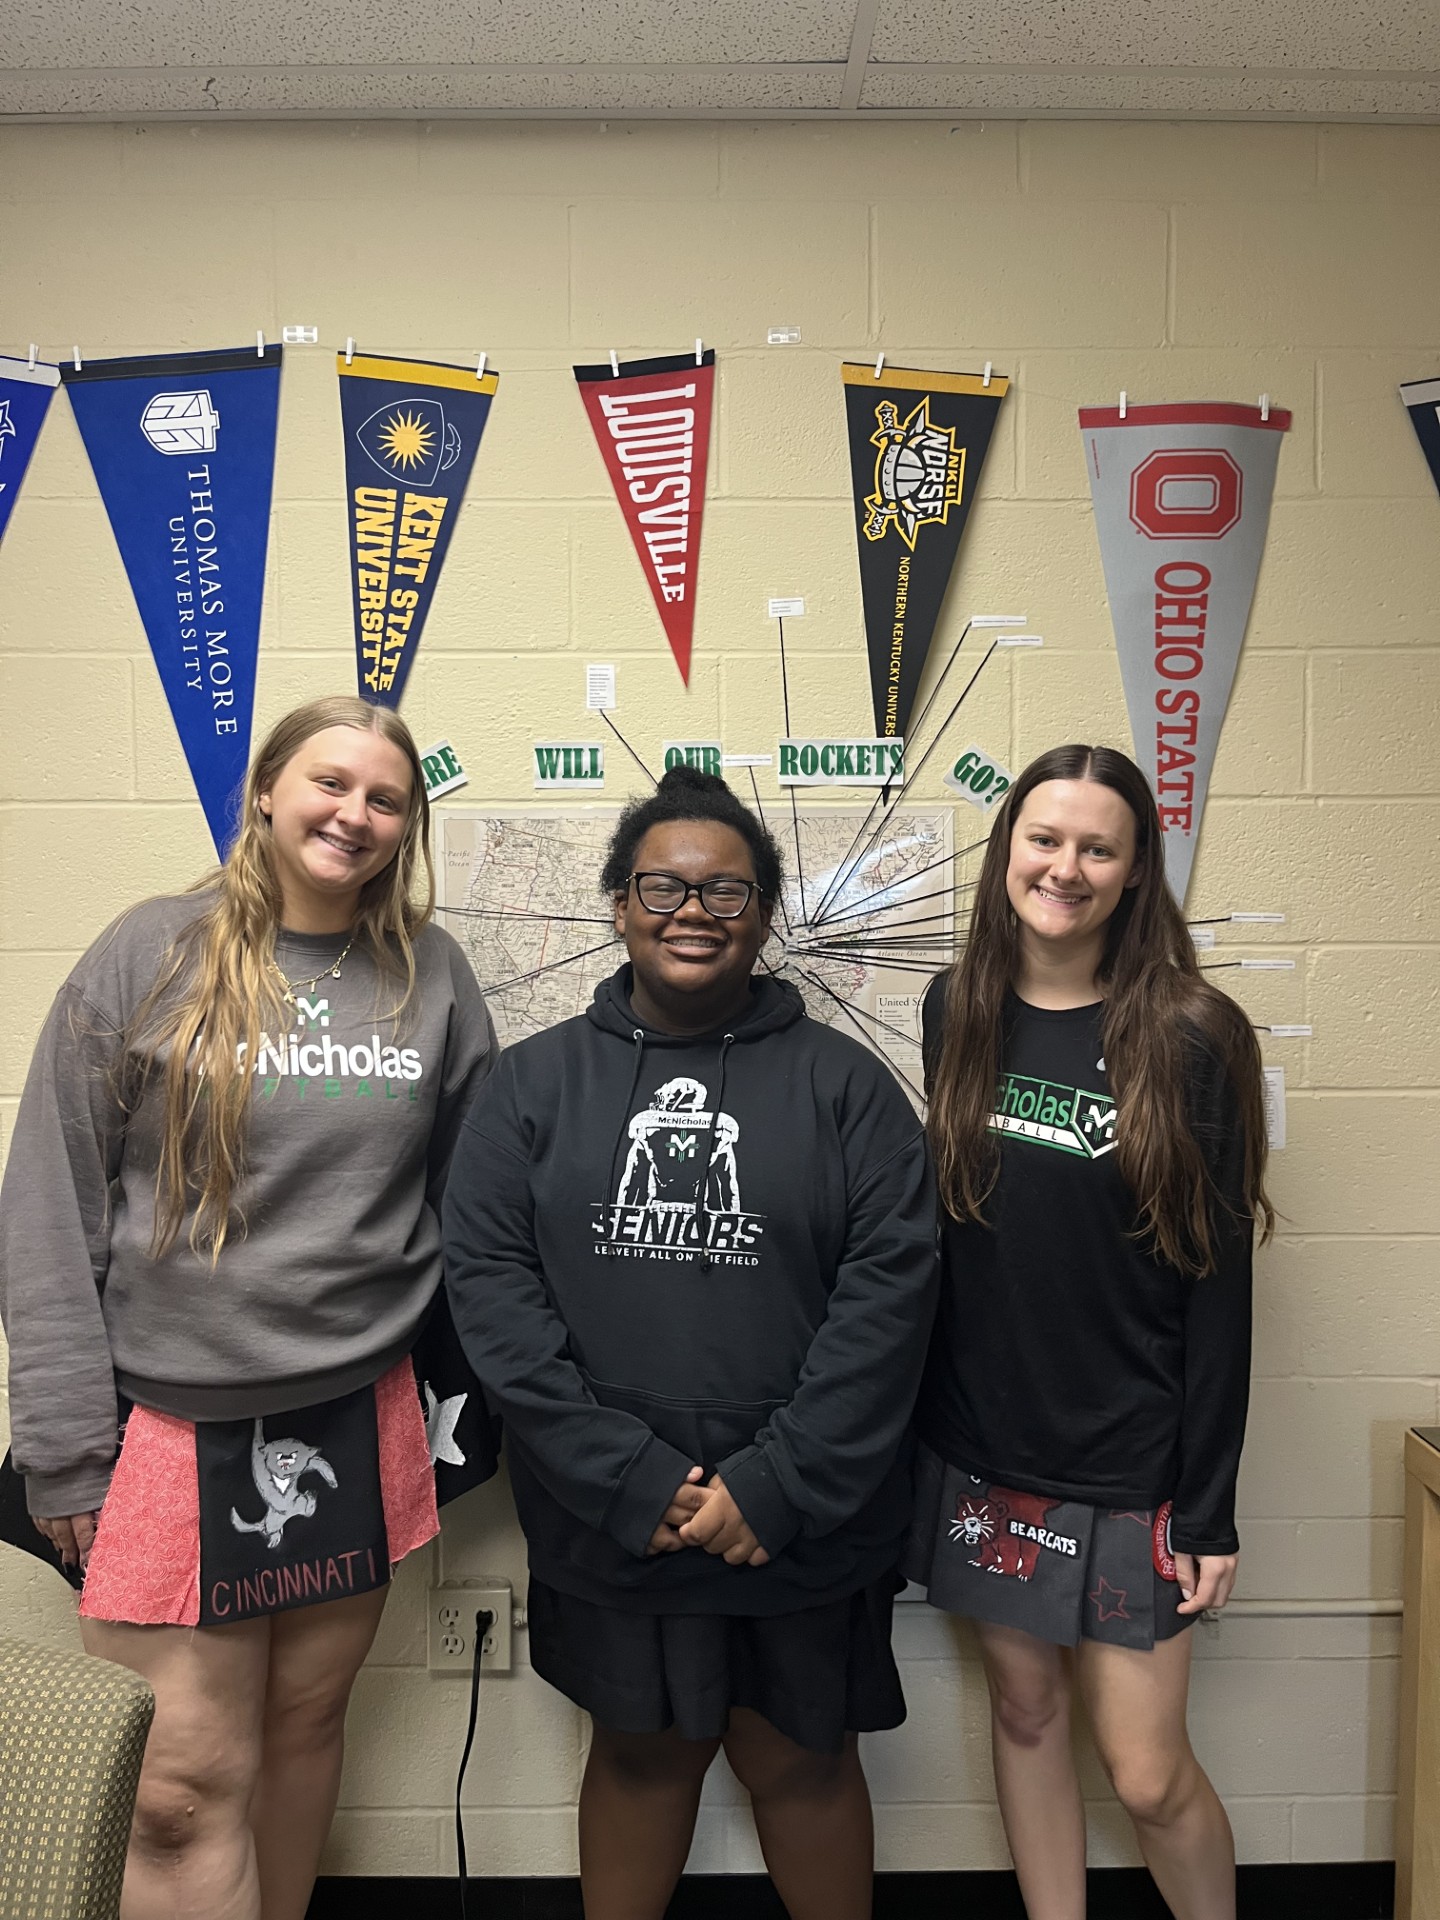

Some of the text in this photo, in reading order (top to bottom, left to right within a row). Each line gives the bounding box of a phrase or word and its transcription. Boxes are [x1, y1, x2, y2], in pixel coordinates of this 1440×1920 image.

[598, 383, 696, 603] LOUISVILLE
[916, 429, 949, 519] NORSE
[945, 454, 960, 498] NKU
[169, 516, 203, 691] UNIVERSITY
[188, 464, 238, 735] THOMAS MORE
[354, 486, 398, 693] UNIVERSITY
[378, 492, 449, 692] KENT STATE
[885, 556, 911, 736] NORTHERN KENTUCKY UNIVERS
[1154, 561, 1212, 832] OHIO STATE
[421, 744, 1009, 804] RE WILL OUR ROCKETS GO?
[879, 997, 910, 1007] United
[196, 1031, 423, 1081] cNicholas
[205, 1078, 418, 1101] FTBALL
[658, 1116, 711, 1126] McNicholas
[591, 1207, 764, 1249] SENIORS
[634, 1249, 645, 1259] IT
[649, 1252, 671, 1261] ALL
[676, 1252, 693, 1262] ON
[725, 1255, 759, 1266] FIELD
[1010, 1521, 1077, 1556] BEARCATS
[211, 1548, 376, 1617] CINCINNATI
